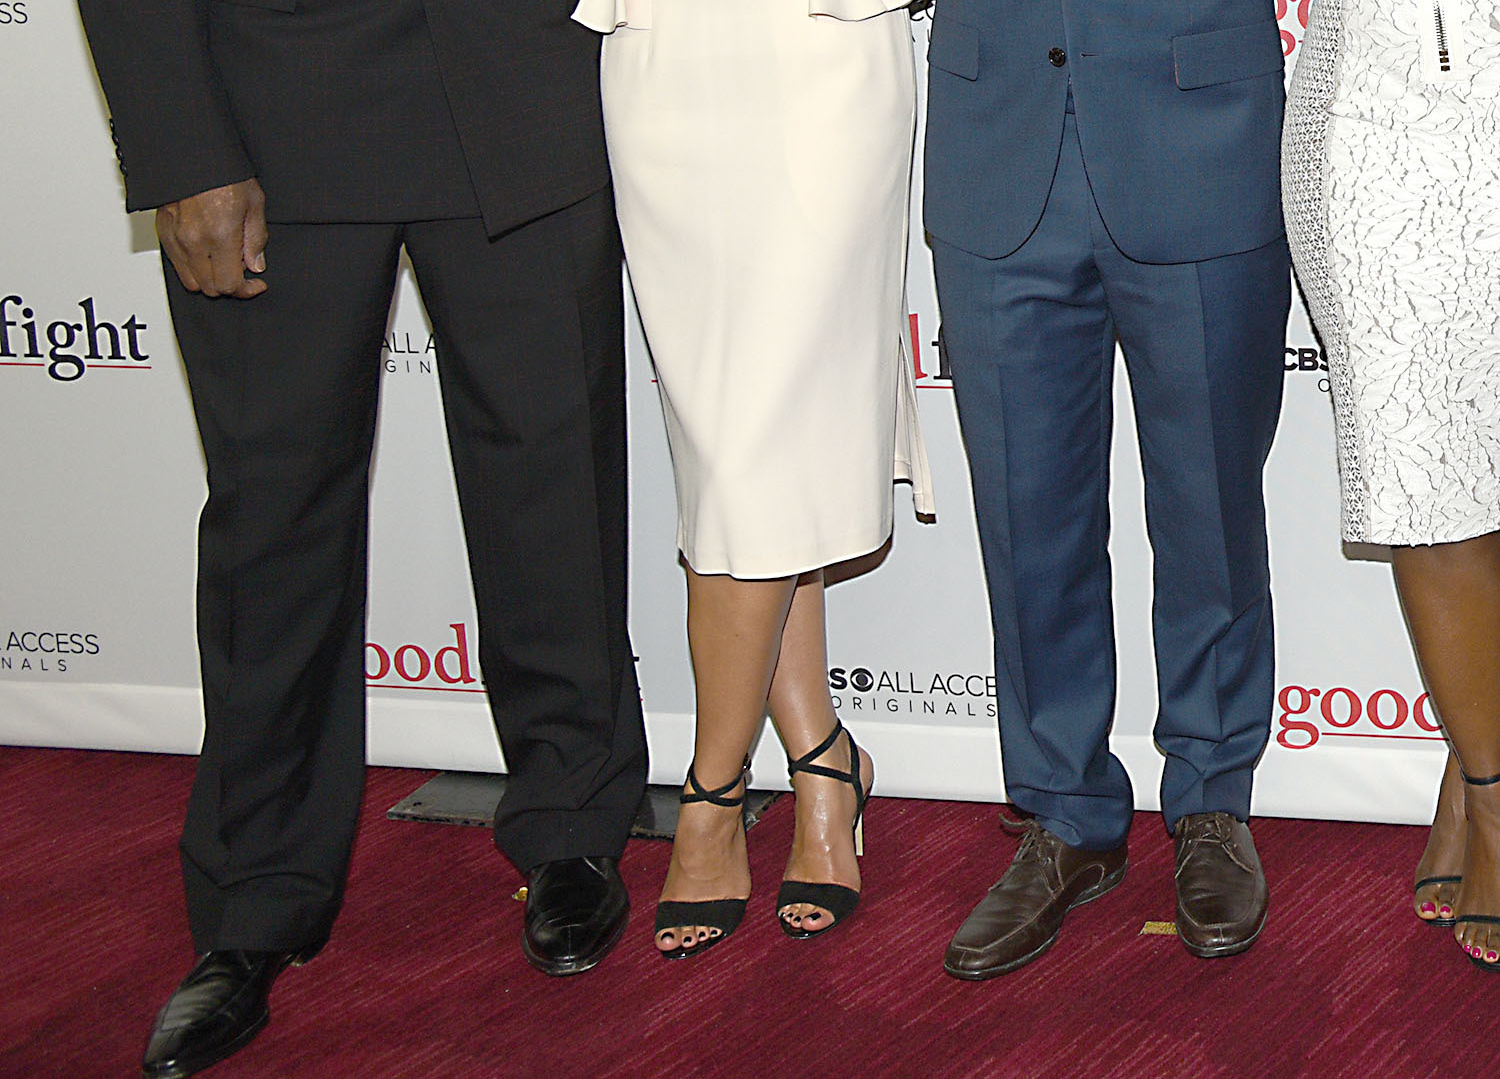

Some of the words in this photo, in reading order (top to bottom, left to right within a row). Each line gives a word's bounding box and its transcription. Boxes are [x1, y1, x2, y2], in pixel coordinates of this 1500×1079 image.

[6, 631, 100, 654] ACCESS
[877, 671, 923, 694] ALL
[929, 673, 997, 697] ACCE
[832, 695, 996, 717] ORIGINALS
